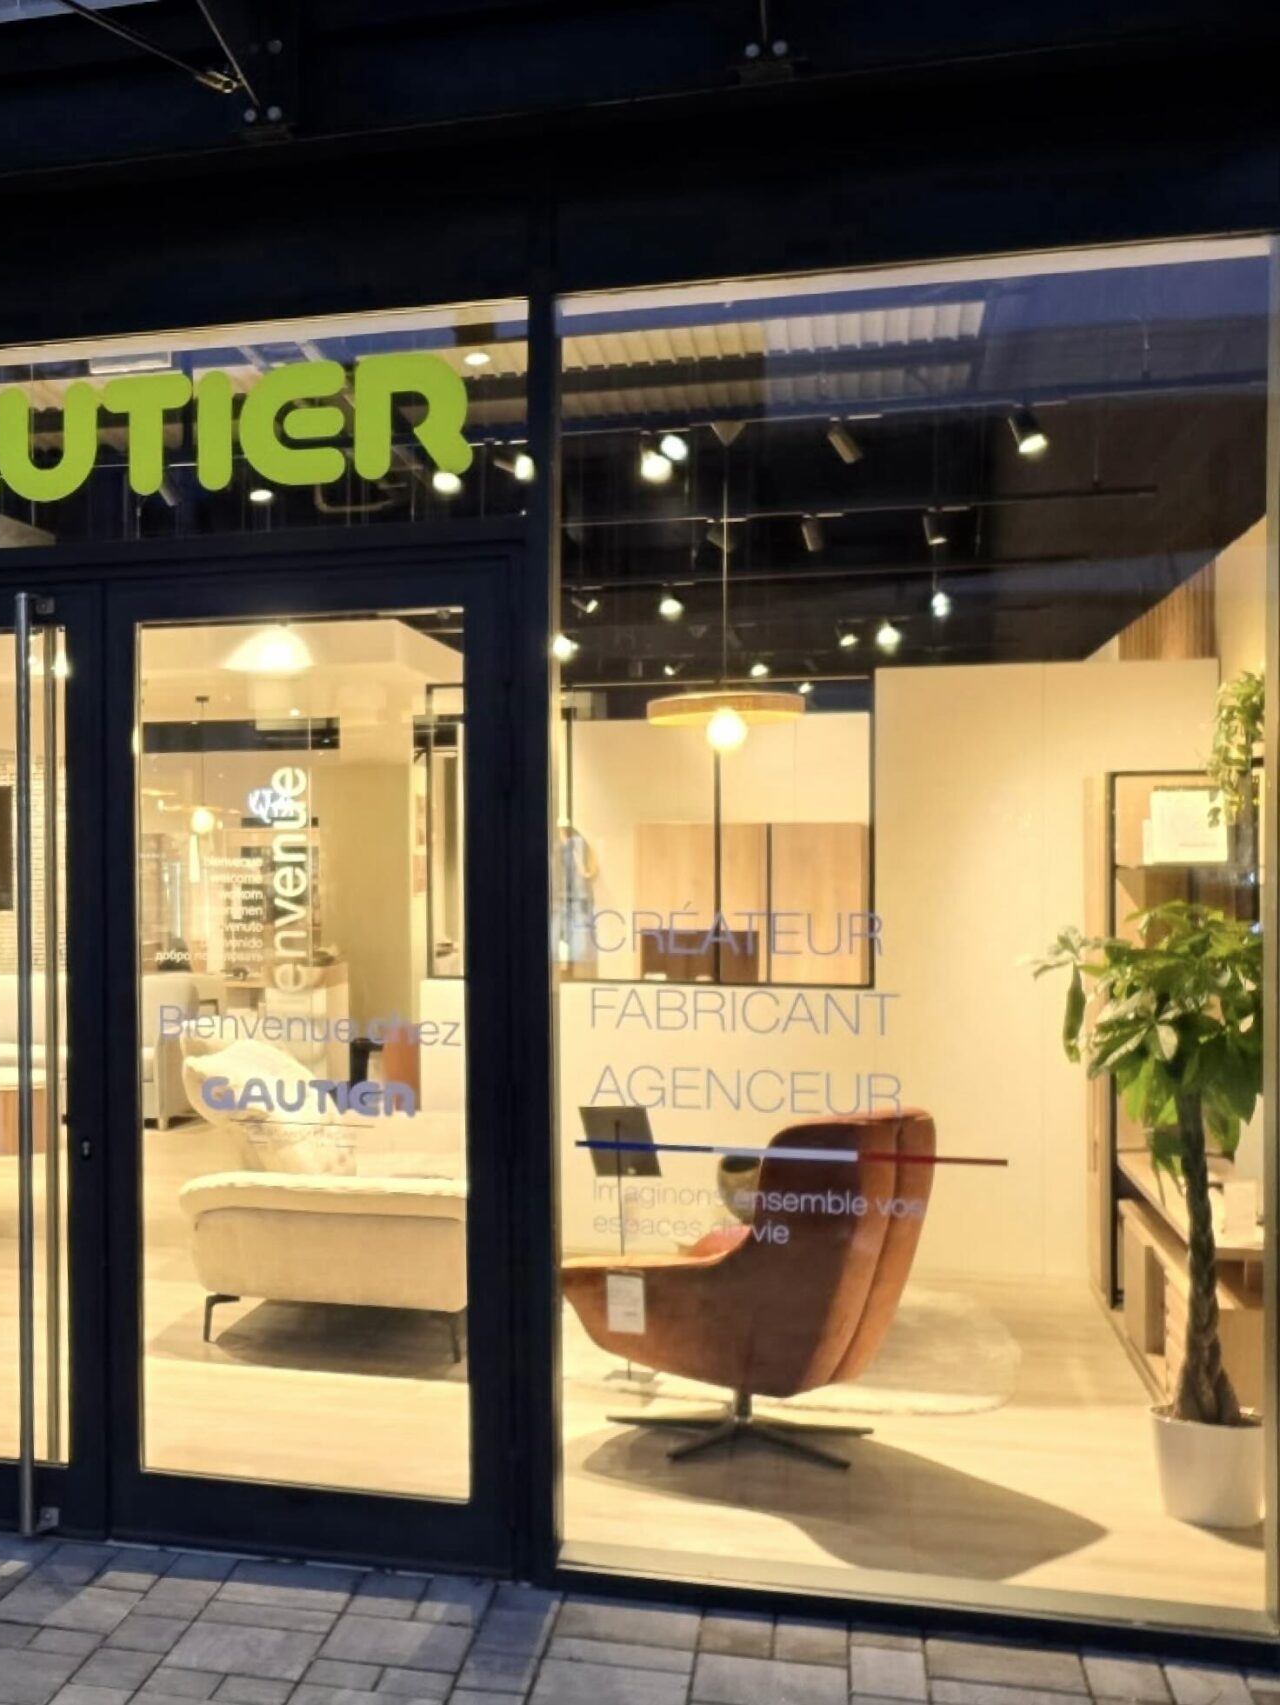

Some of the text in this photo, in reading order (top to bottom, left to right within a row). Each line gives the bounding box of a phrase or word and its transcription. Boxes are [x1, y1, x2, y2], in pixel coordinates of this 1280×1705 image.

[271, 767, 308, 992] envenue
[591, 902, 884, 957] CRÉATEUR
[159, 1004, 461, 1047] Bienvenue chez
[590, 987, 901, 1037] FABRICANT
[201, 1076, 417, 1118] GAUTIER
[589, 1064, 904, 1118] AGENCEUR
[732, 1187, 868, 1217] ensemble
[751, 1219, 790, 1245] vie
